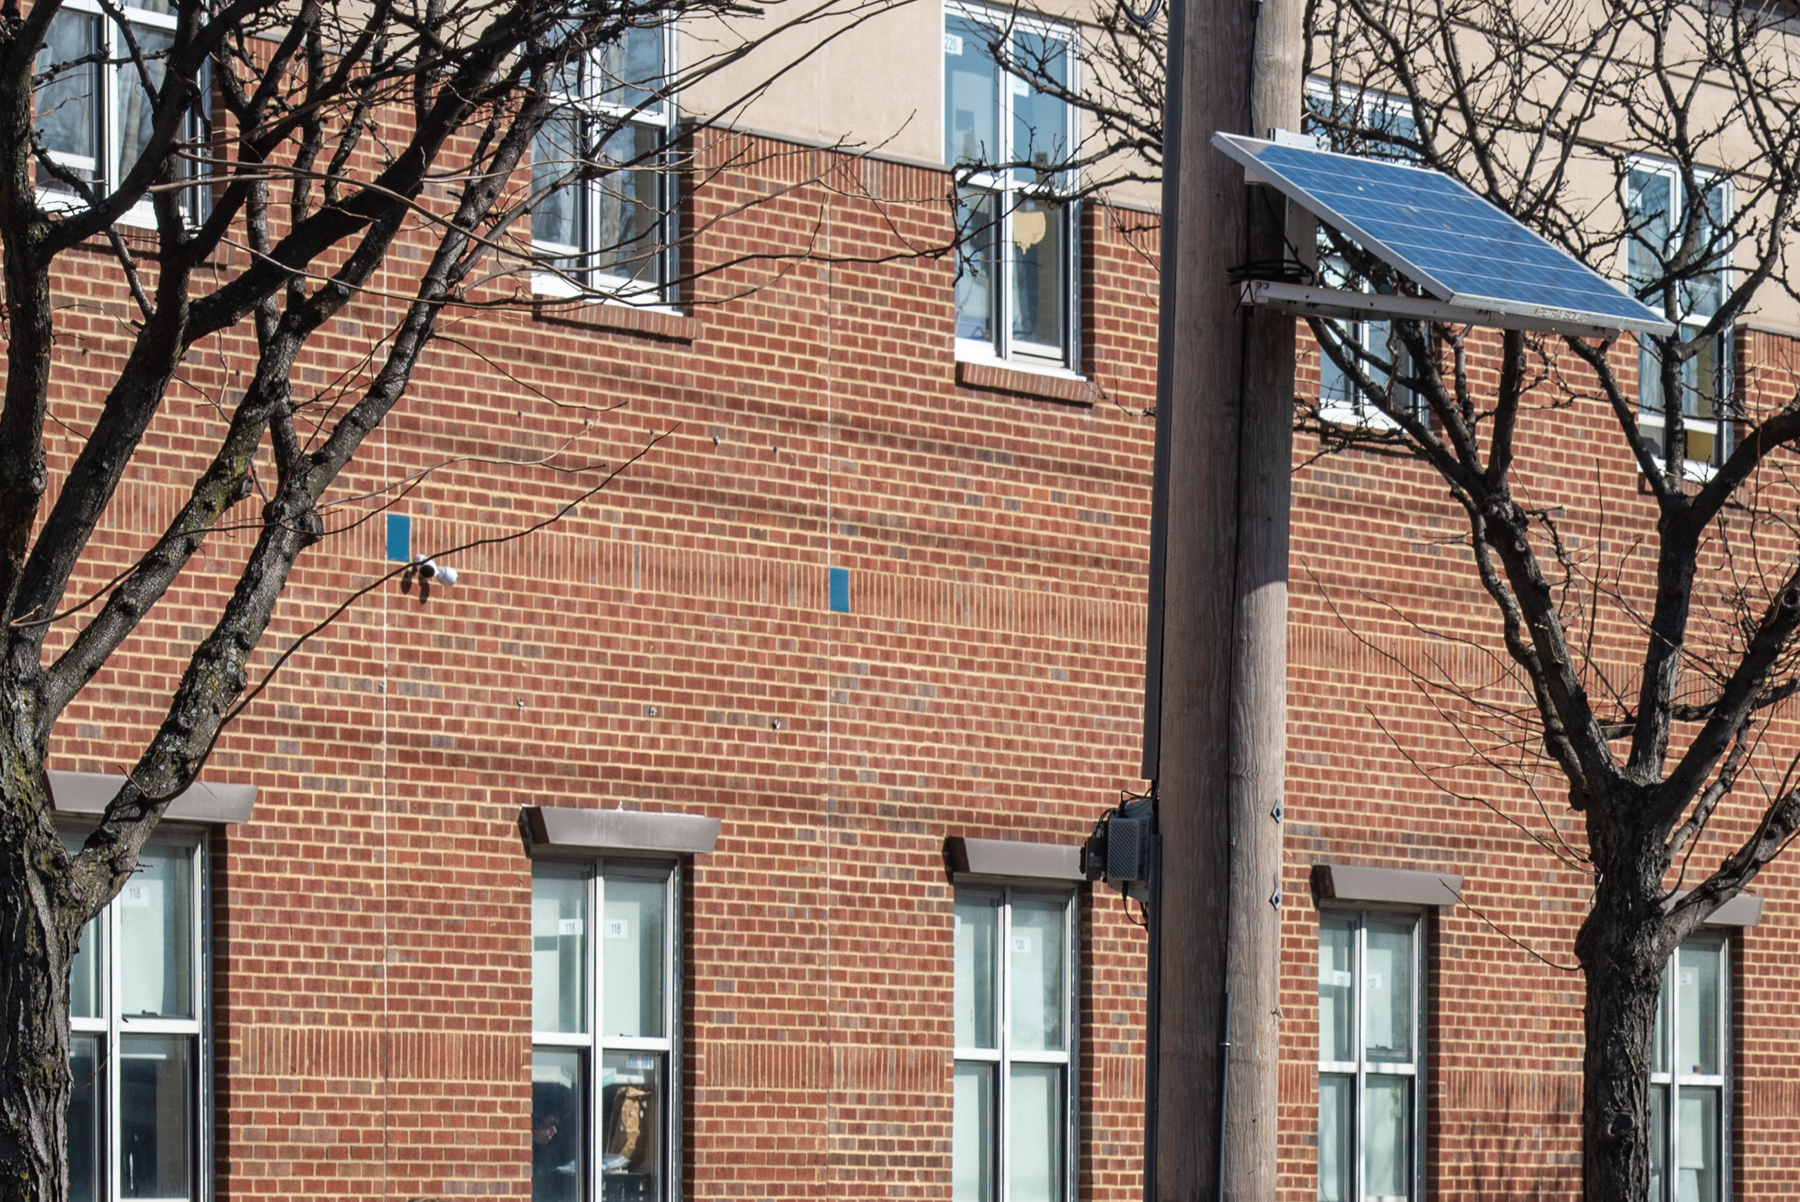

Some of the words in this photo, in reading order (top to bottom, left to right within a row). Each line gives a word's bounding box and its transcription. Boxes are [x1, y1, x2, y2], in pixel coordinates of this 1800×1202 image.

[129, 887, 141, 899] 118
[565, 922, 576, 933] 118
[611, 923, 622, 934] 118
